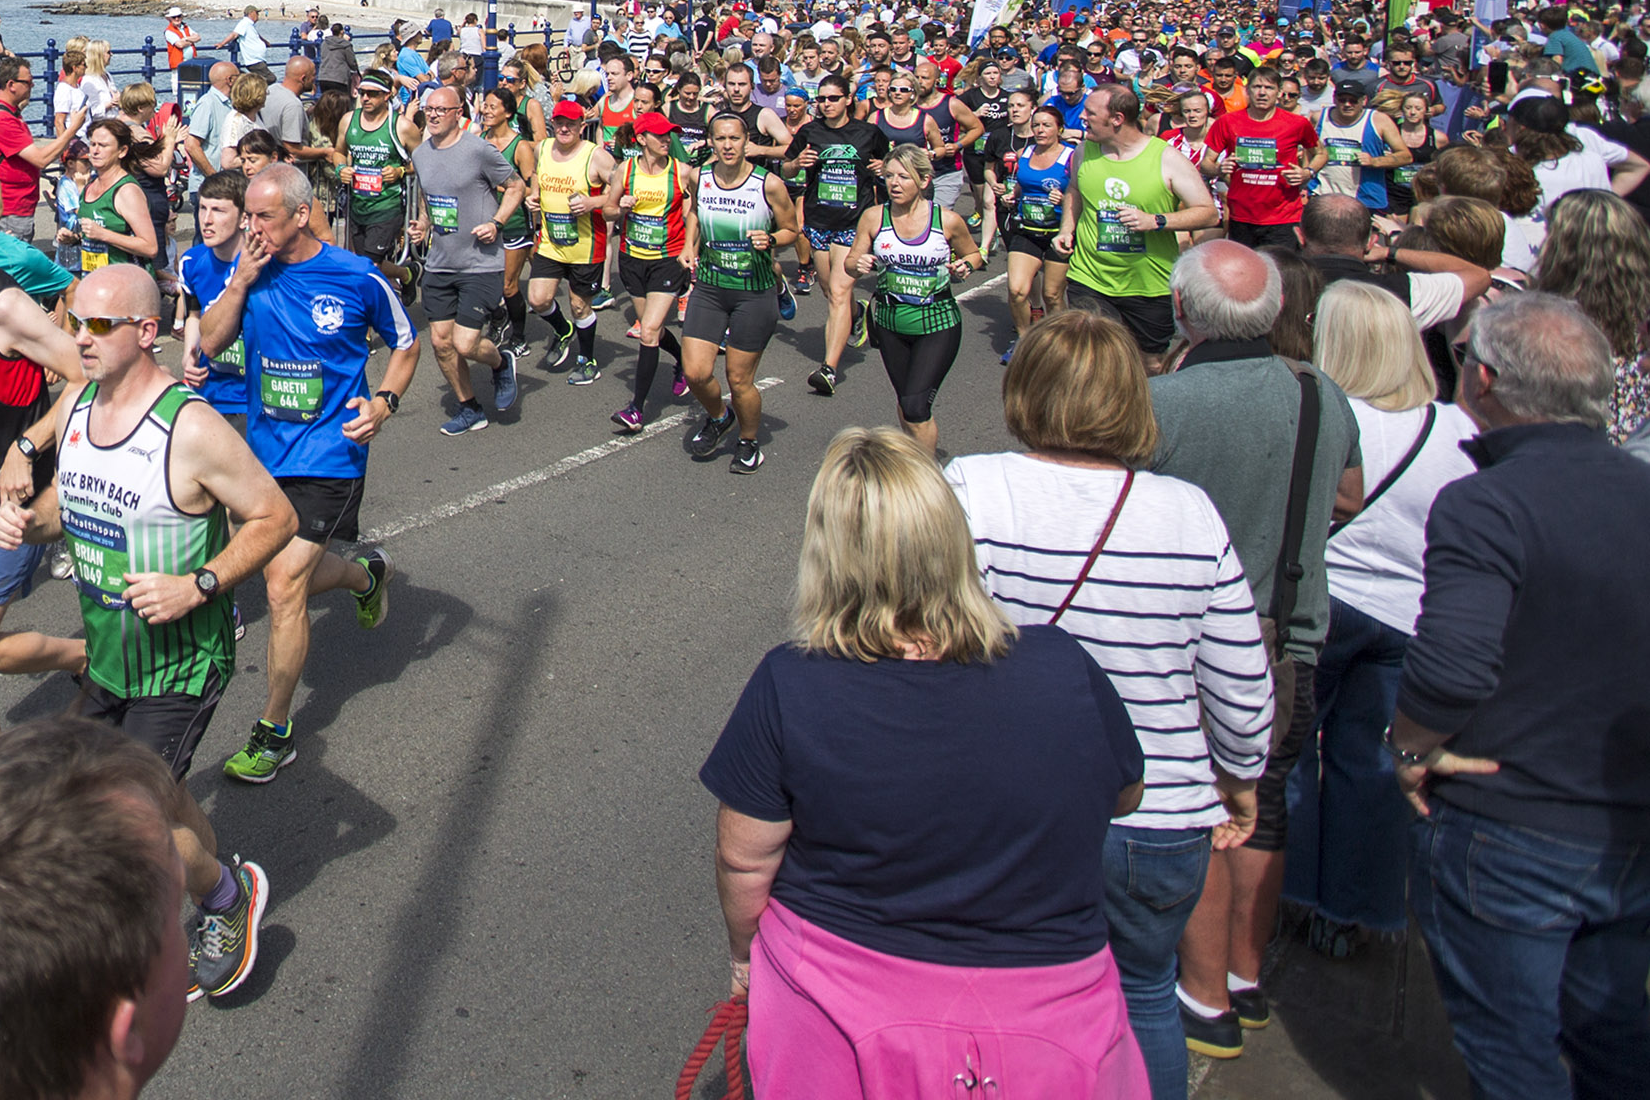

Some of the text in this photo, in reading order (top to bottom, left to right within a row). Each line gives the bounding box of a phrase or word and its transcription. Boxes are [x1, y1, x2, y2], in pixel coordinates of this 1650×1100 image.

[1248, 148, 1263, 156] PAUL
[540, 173, 577, 187] Cornelly
[541, 181, 575, 194] Striders
[634, 188, 666, 198] Cornelly
[829, 185, 847, 193] SALLY
[702, 196, 756, 210] PARC BRYN BACH
[708, 205, 748, 215] Running Club
[1105, 225, 1135, 234] ANDRE
[898, 253, 927, 265] BRYN
[895, 275, 930, 287] KATHRYN
[269, 361, 318, 372] healthspan
[271, 379, 308, 395] GARETH
[279, 394, 299, 409] 644
[79, 473, 107, 496] BRYN
[107, 482, 141, 512] BACH
[63, 490, 123, 518] Running Club
[70, 514, 121, 539] healthspan
[74, 541, 104, 568] BRIAN
[77, 561, 103, 587] 1049
